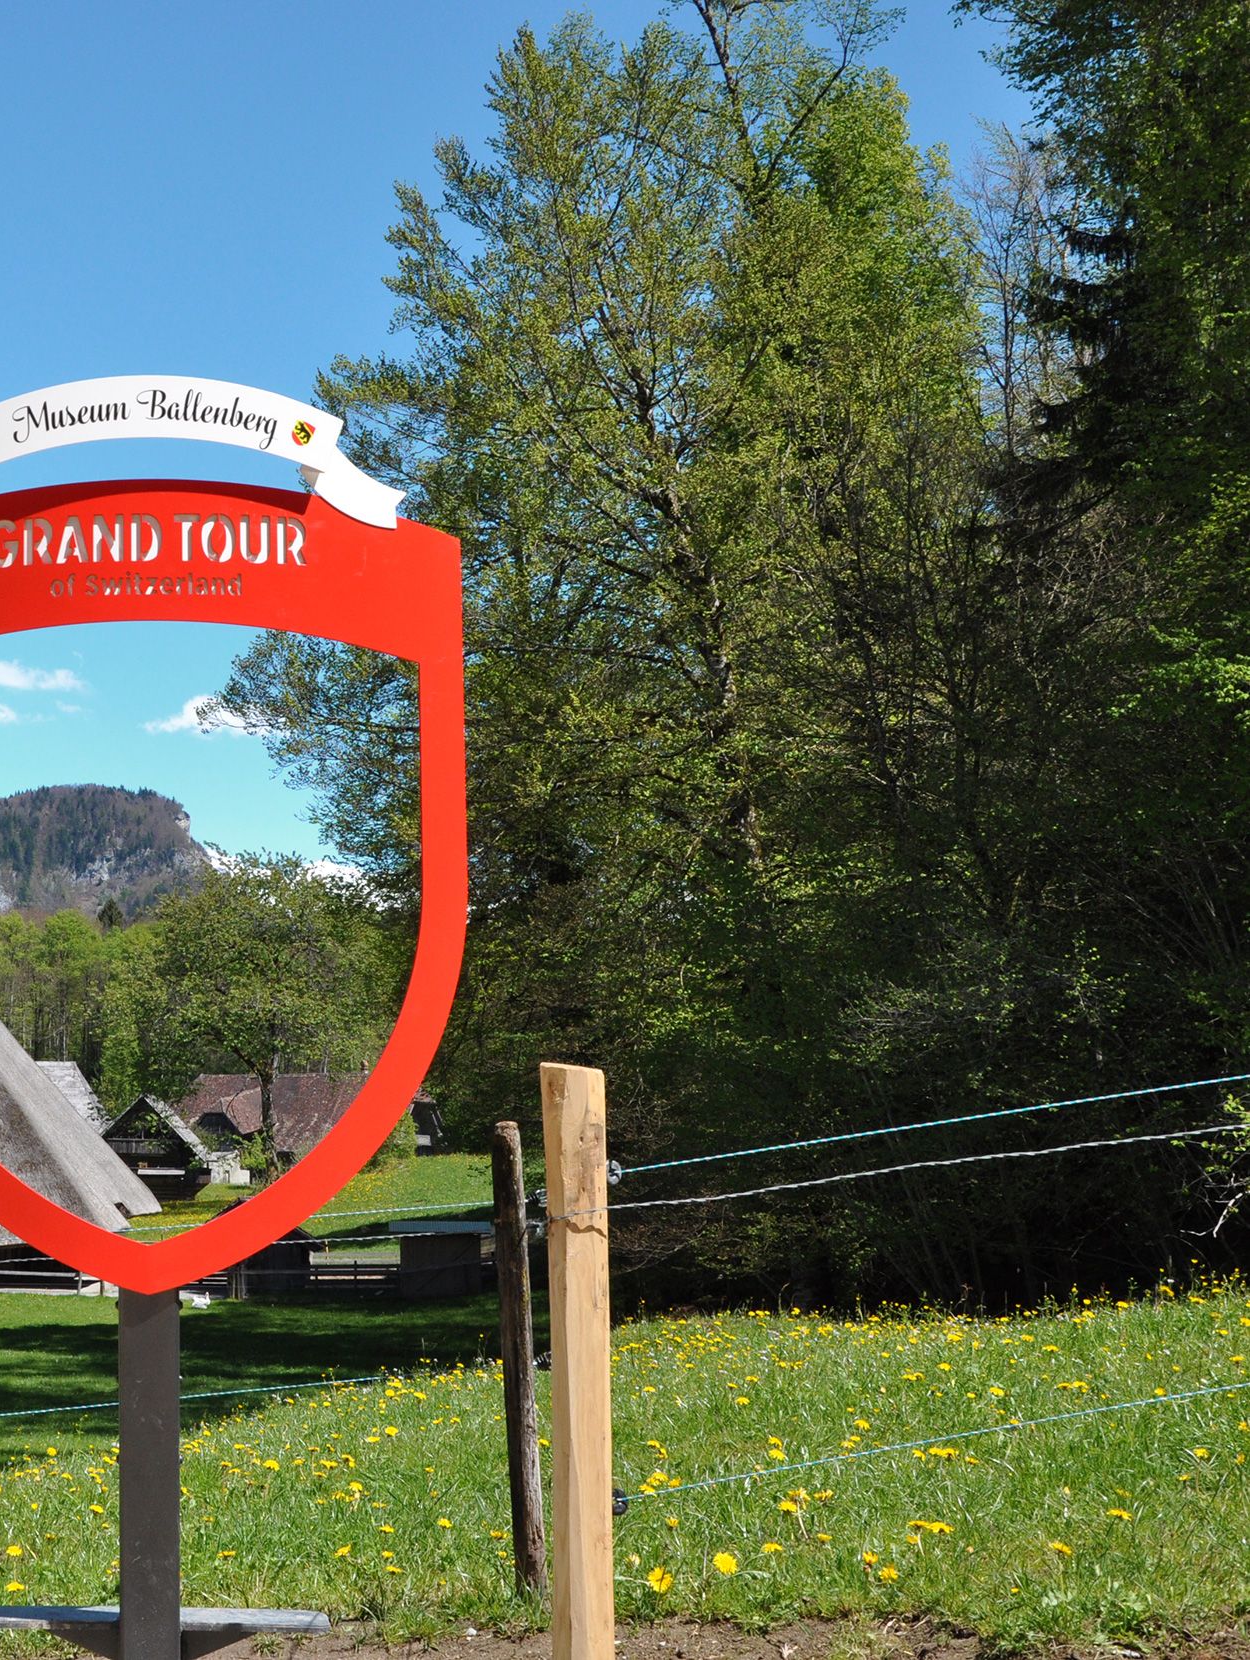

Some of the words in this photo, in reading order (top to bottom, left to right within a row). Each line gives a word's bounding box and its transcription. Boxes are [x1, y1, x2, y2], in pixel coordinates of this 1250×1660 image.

[12, 400, 131, 443] Museum
[136, 389, 279, 450] Ballenberg
[173, 513, 308, 567] TOUR
[50, 574, 77, 598] of
[84, 572, 243, 597] Switzerland
